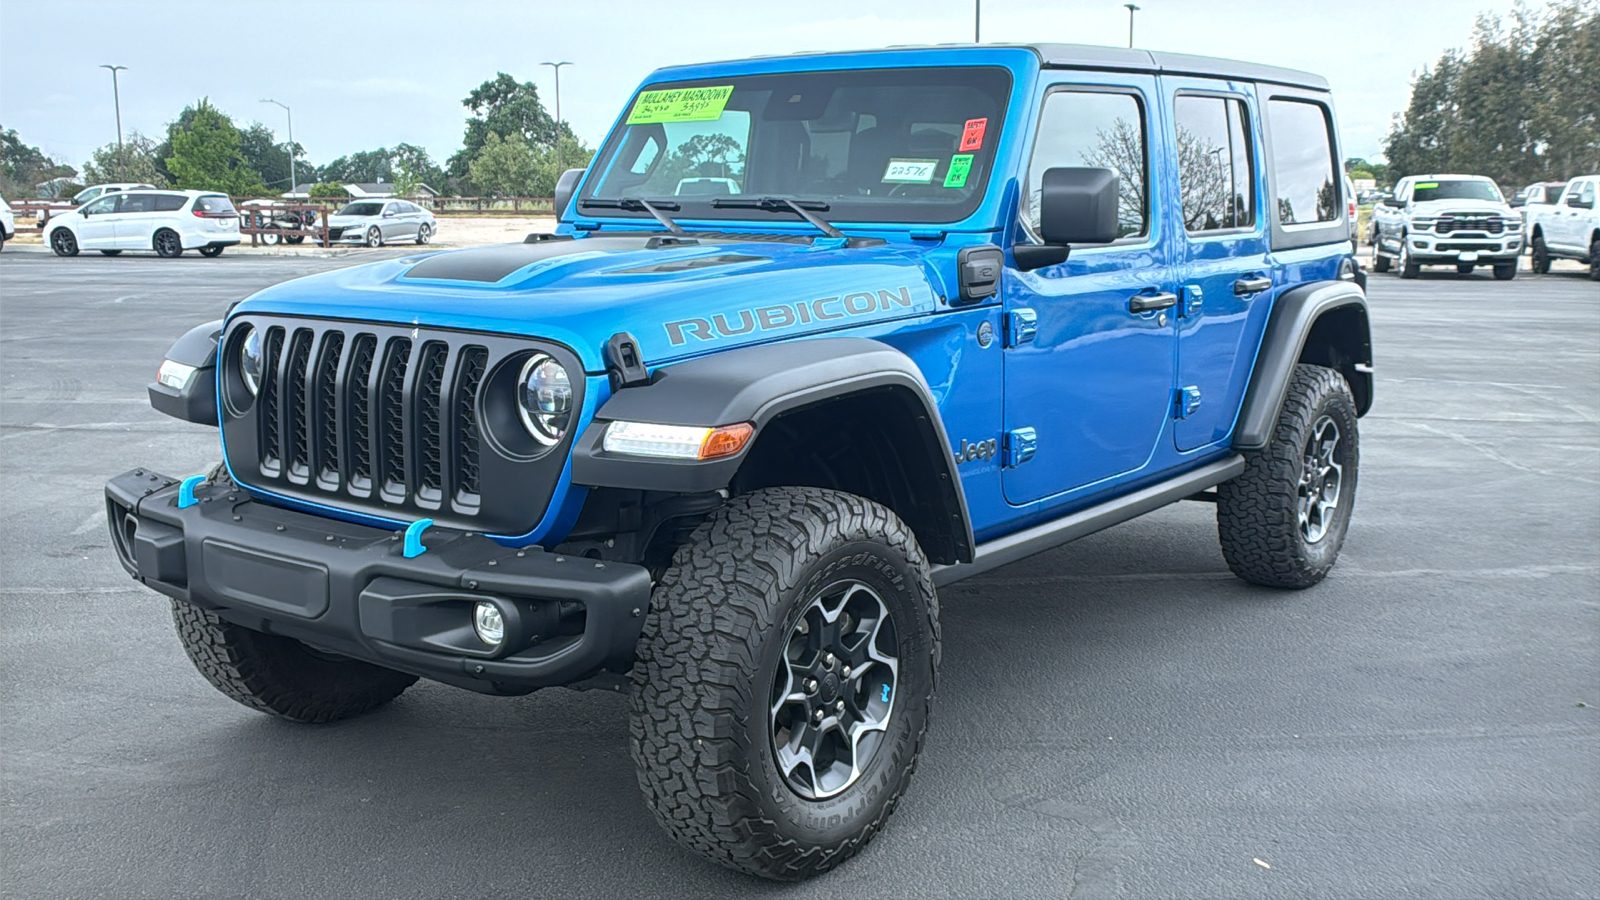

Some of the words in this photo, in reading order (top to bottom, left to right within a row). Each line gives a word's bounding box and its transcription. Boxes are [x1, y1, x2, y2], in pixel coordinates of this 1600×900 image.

[681, 87, 730, 102] MARKDOWN
[891, 166, 928, 177] 22576
[664, 287, 912, 347] RUBICON
[954, 438, 997, 464] Jeep
